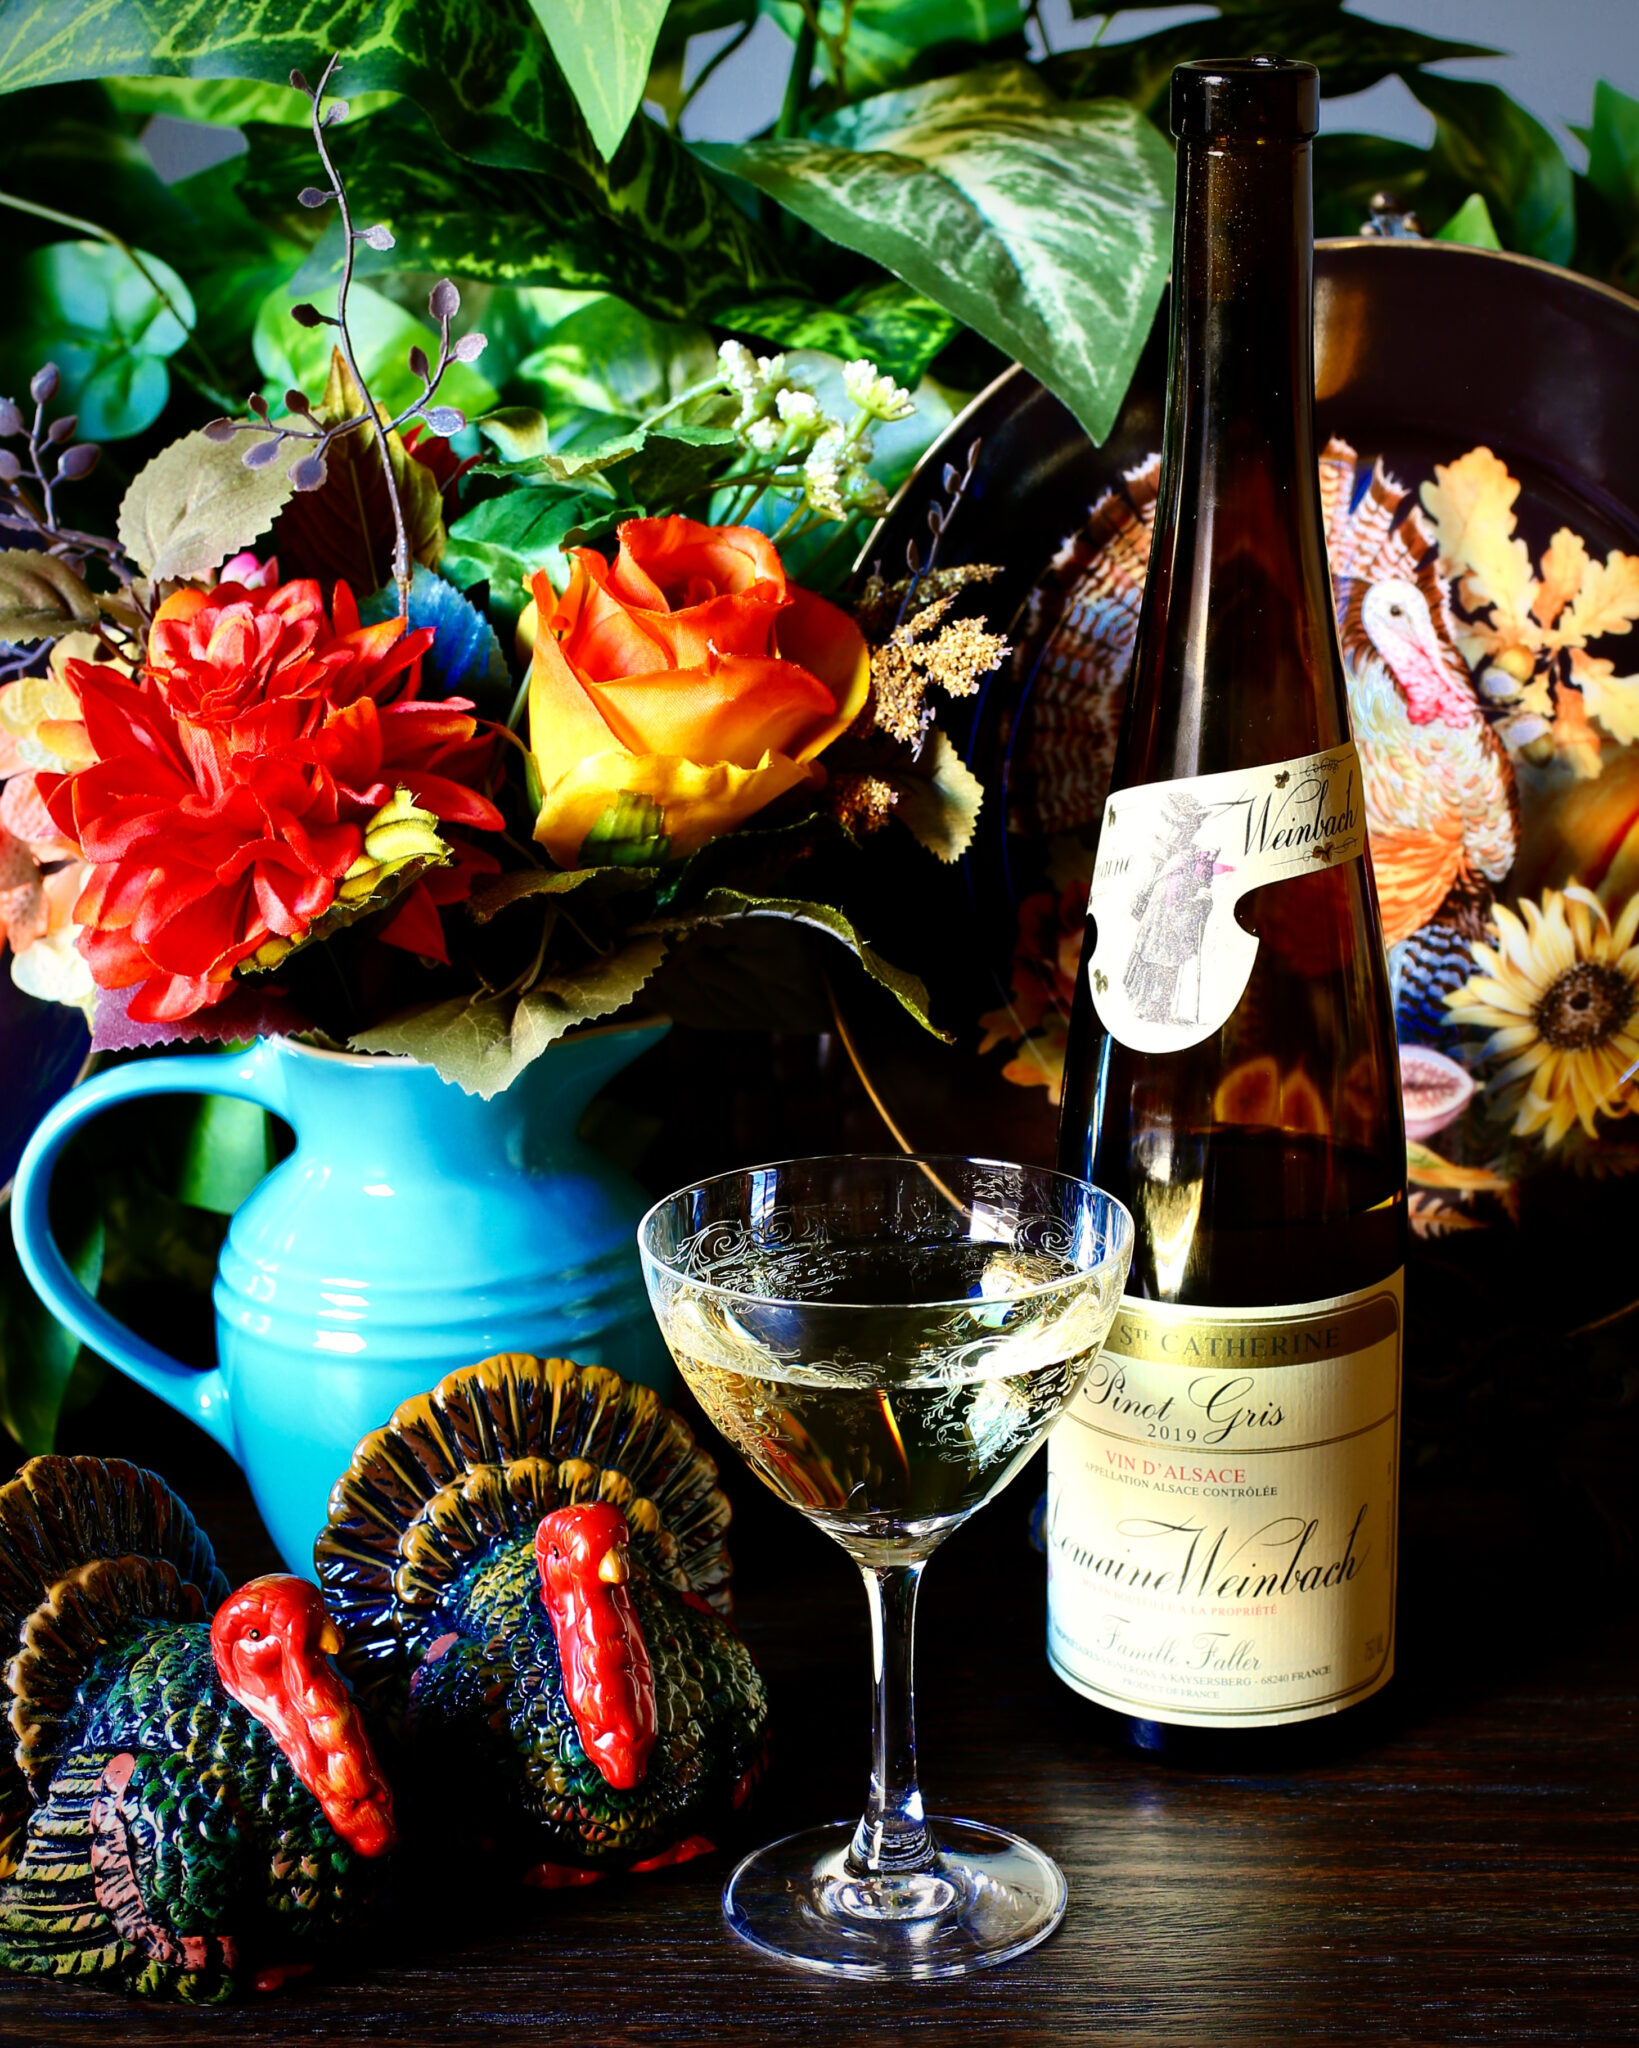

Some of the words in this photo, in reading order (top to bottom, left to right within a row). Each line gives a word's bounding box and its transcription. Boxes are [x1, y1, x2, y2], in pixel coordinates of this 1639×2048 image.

[1209, 770, 1358, 857] Weinbach
[1161, 1327, 1340, 1358] CATHERINE
[1083, 1354, 1175, 1422] Pinot
[1188, 1376, 1286, 1445] Gris
[1146, 1422, 1197, 1444] 2019
[1084, 1461, 1150, 1489] APPELLATION
[1153, 1482, 1200, 1497] ALSACE
[1203, 1485, 1278, 1497] CONTRÔLÉE
[1105, 1450, 1136, 1472] VIN
[1143, 1460, 1247, 1484] D'ALSACE
[1116, 1504, 1371, 1599] Weinbach
[1191, 1605, 1207, 1616] LA
[1210, 1603, 1278, 1617] PROPRIÉTÉ
[1095, 1614, 1181, 1666] Famille
[1186, 1631, 1262, 1672] Faller
[1170, 1672, 1252, 1687] KAYSERSBERG
[1261, 1674, 1290, 1685] 68240
[1291, 1664, 1332, 1682] FRANCE
[1180, 1687, 1221, 1699] FRANCE
